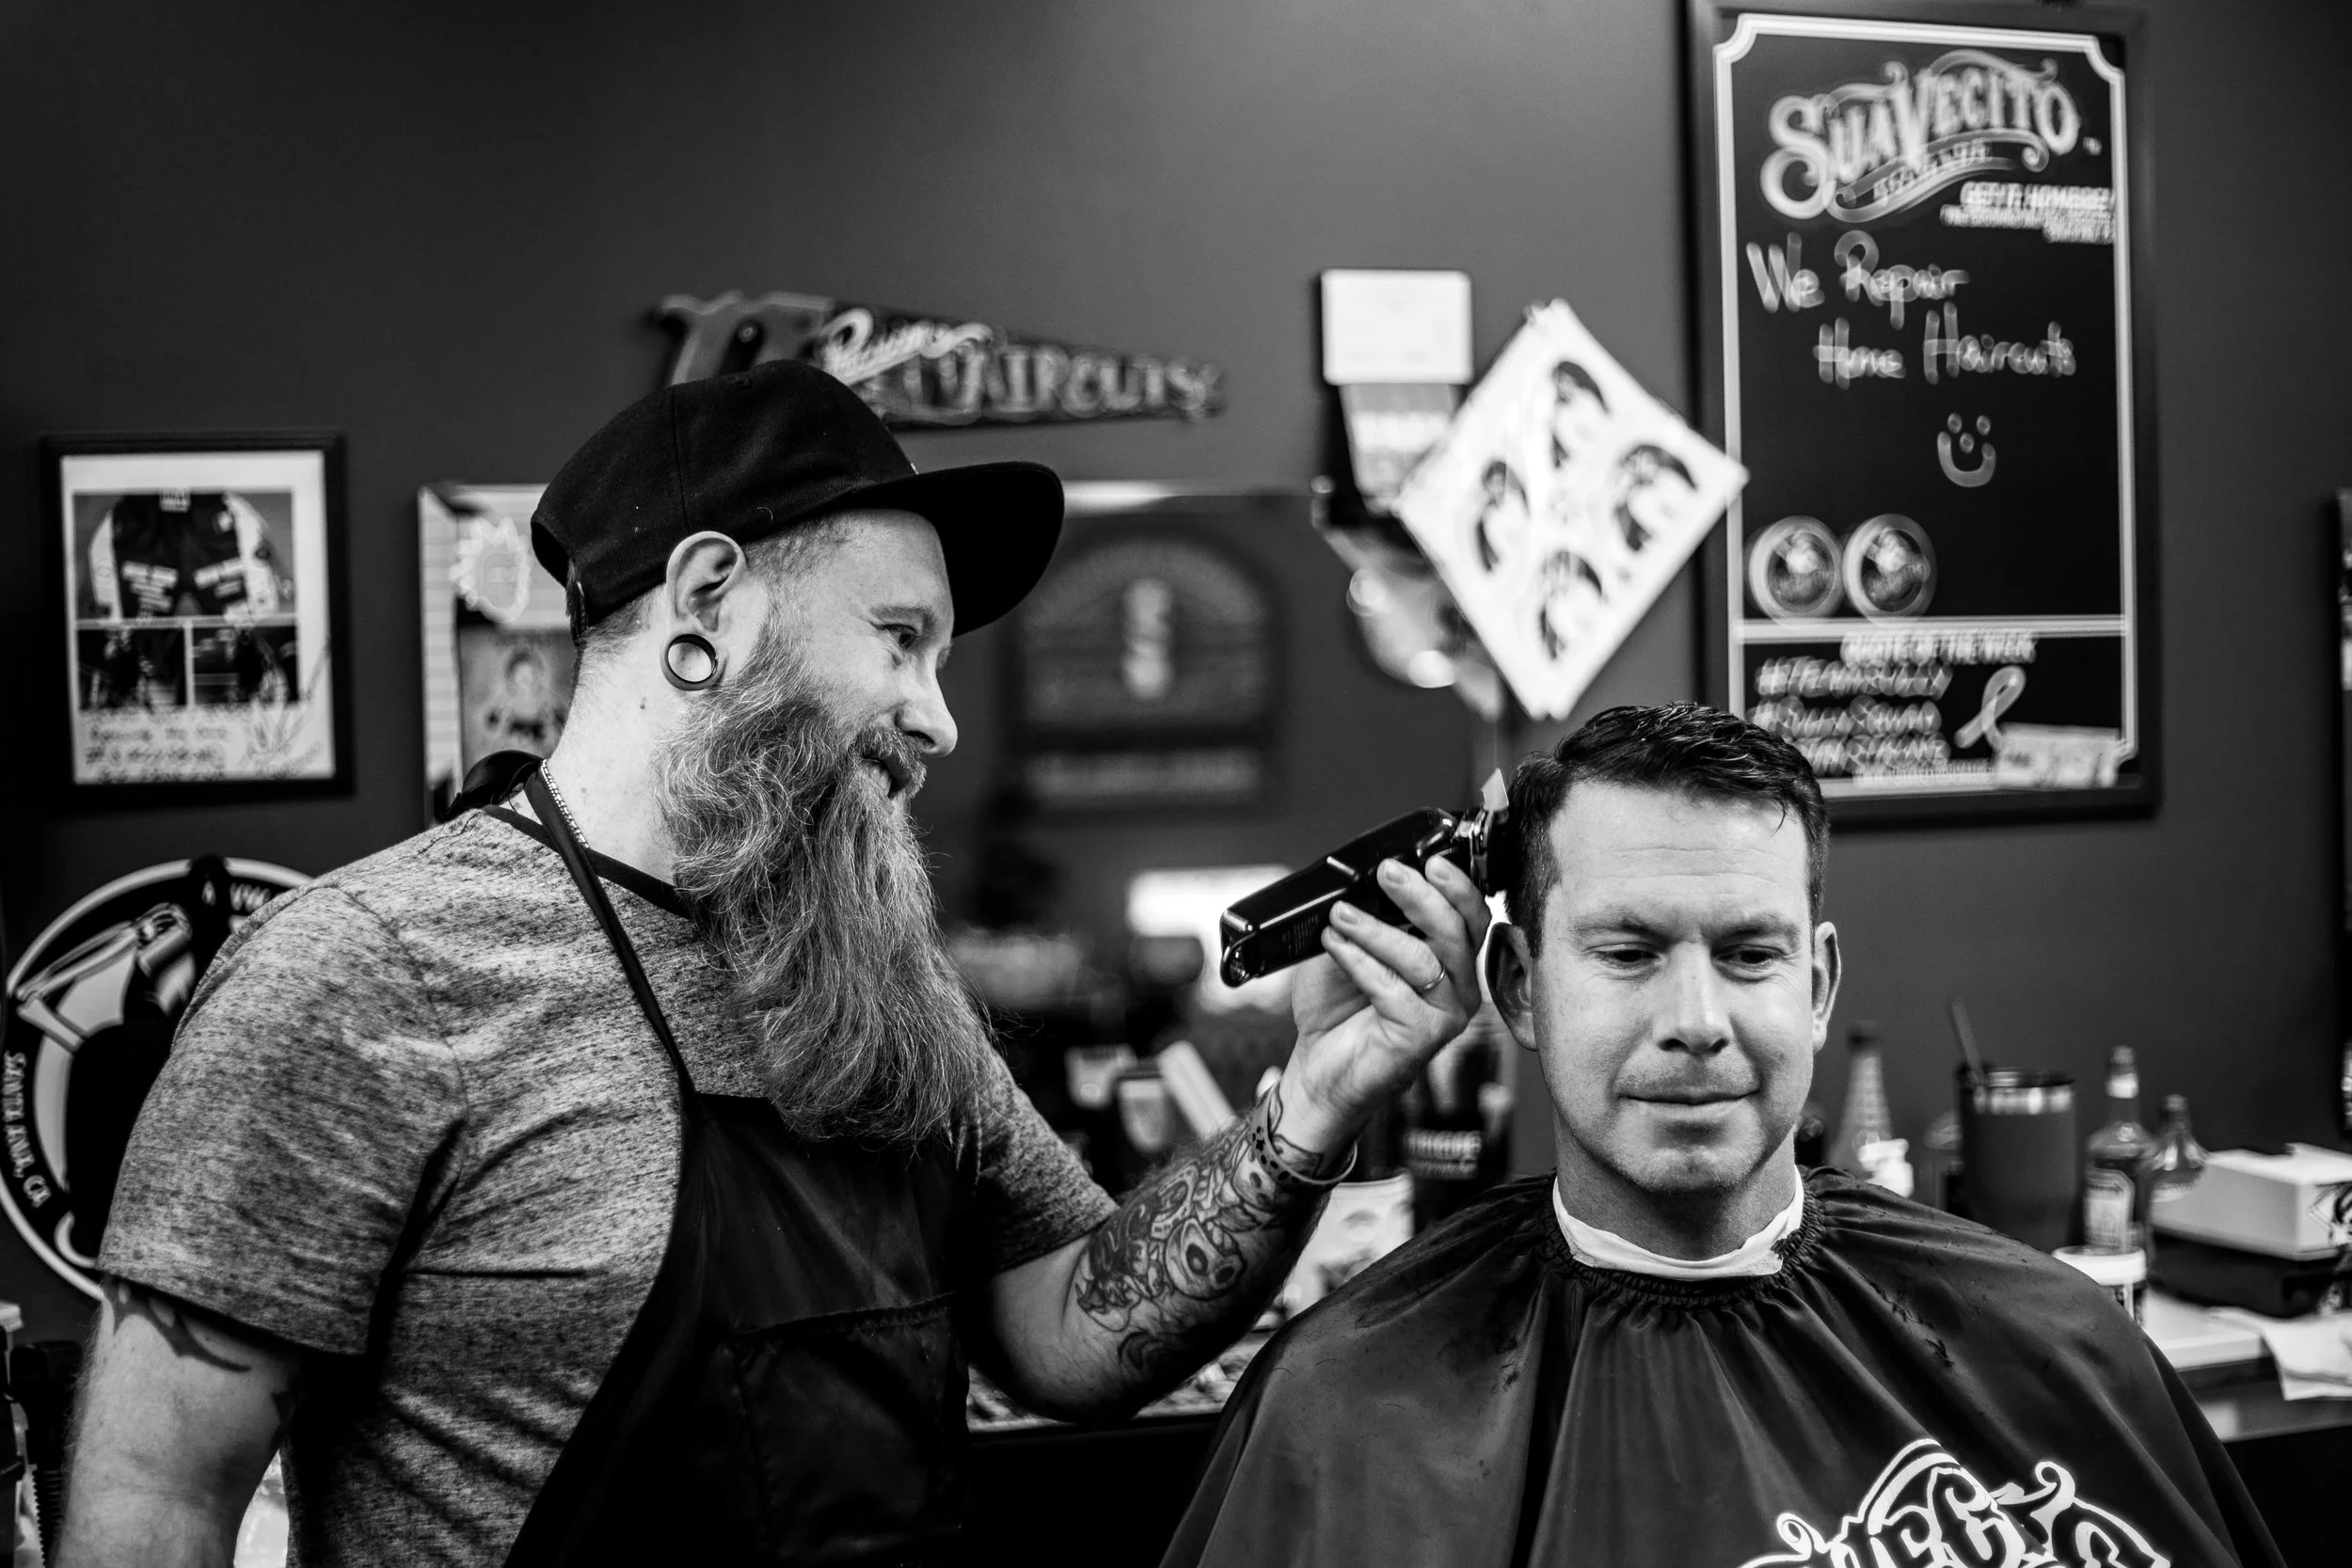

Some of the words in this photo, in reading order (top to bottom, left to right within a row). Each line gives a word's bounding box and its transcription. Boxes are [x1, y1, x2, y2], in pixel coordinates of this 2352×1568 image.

[1746, 232, 1824, 312] We
[1834, 230, 1971, 329] Repair
[1923, 301, 2076, 385] Haircuts
